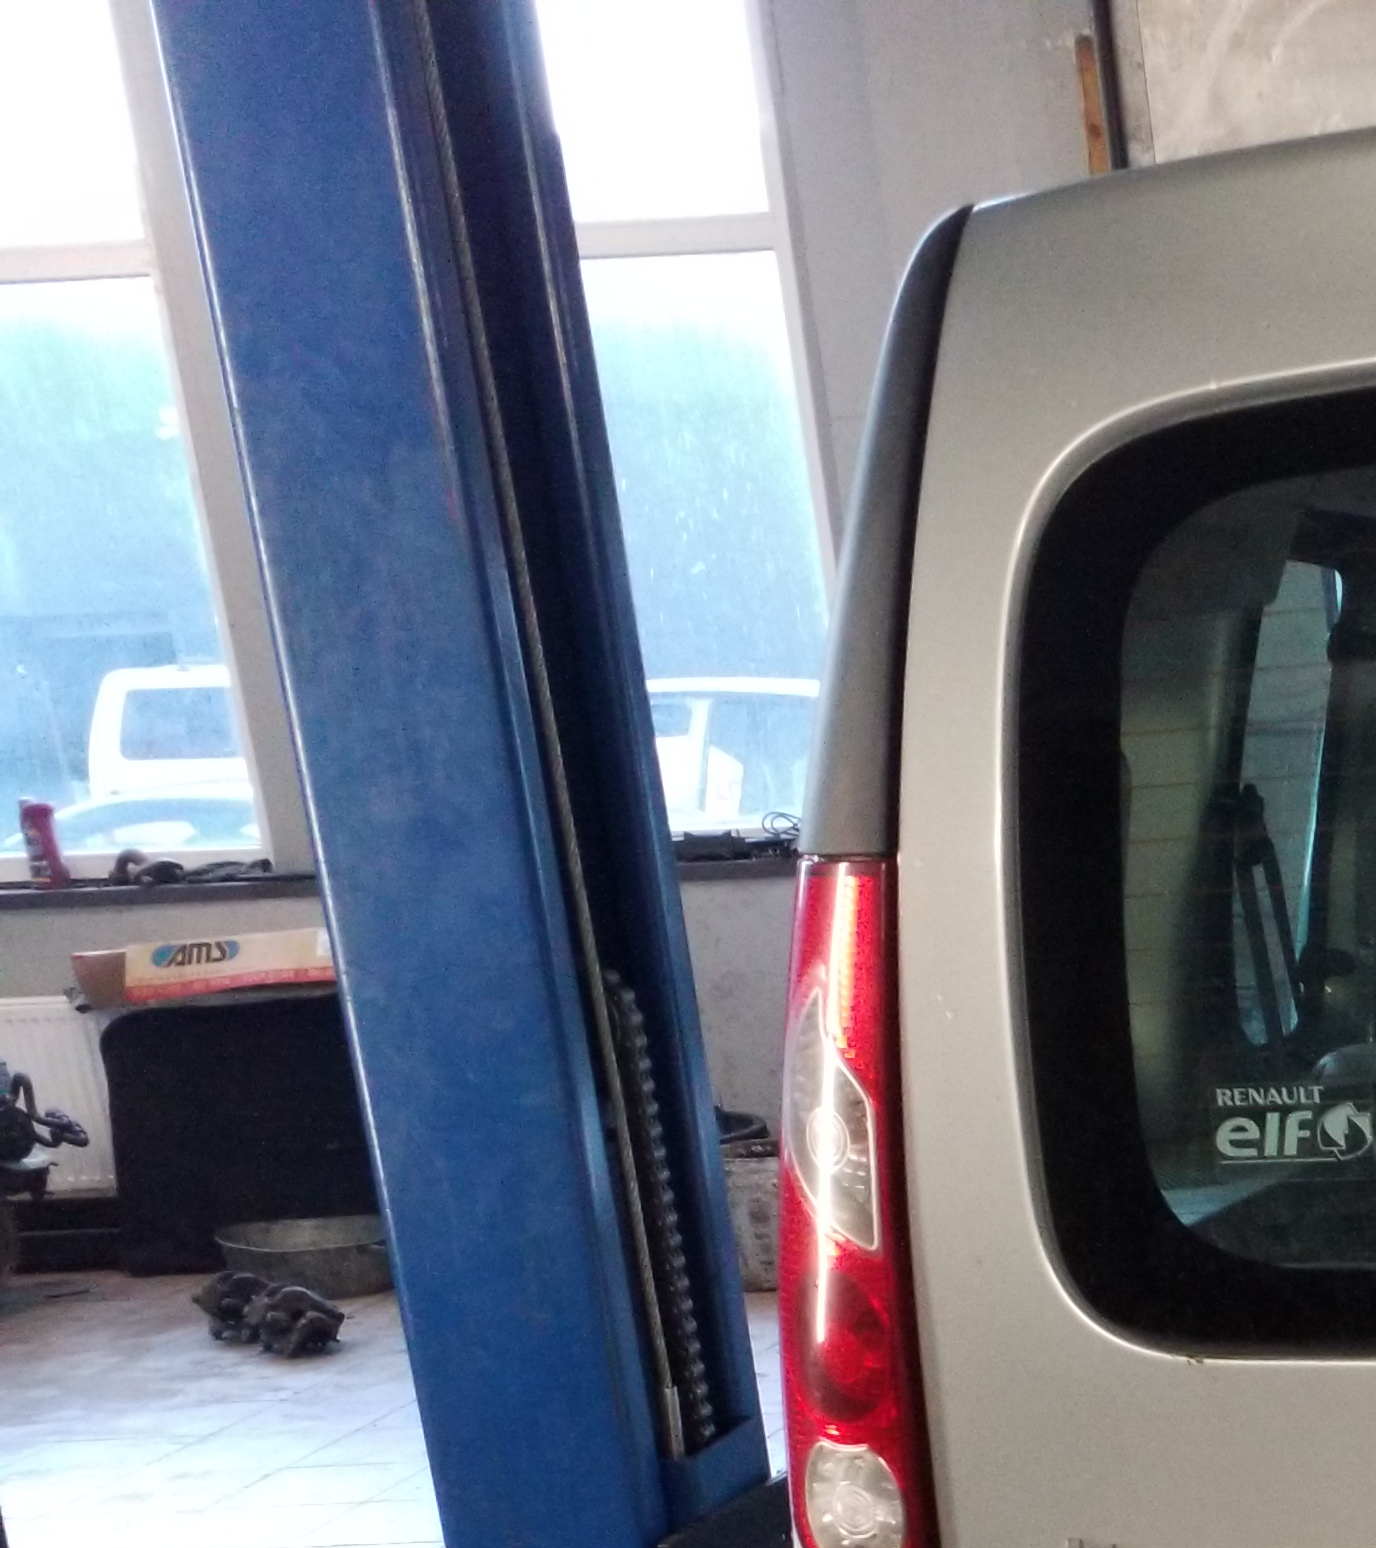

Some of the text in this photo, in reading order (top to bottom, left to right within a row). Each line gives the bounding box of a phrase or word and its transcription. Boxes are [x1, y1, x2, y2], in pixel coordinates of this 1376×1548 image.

[164, 941, 227, 968] AMS
[1215, 1085, 1324, 1106] RENAULT
[1216, 1110, 1313, 1157] elf
